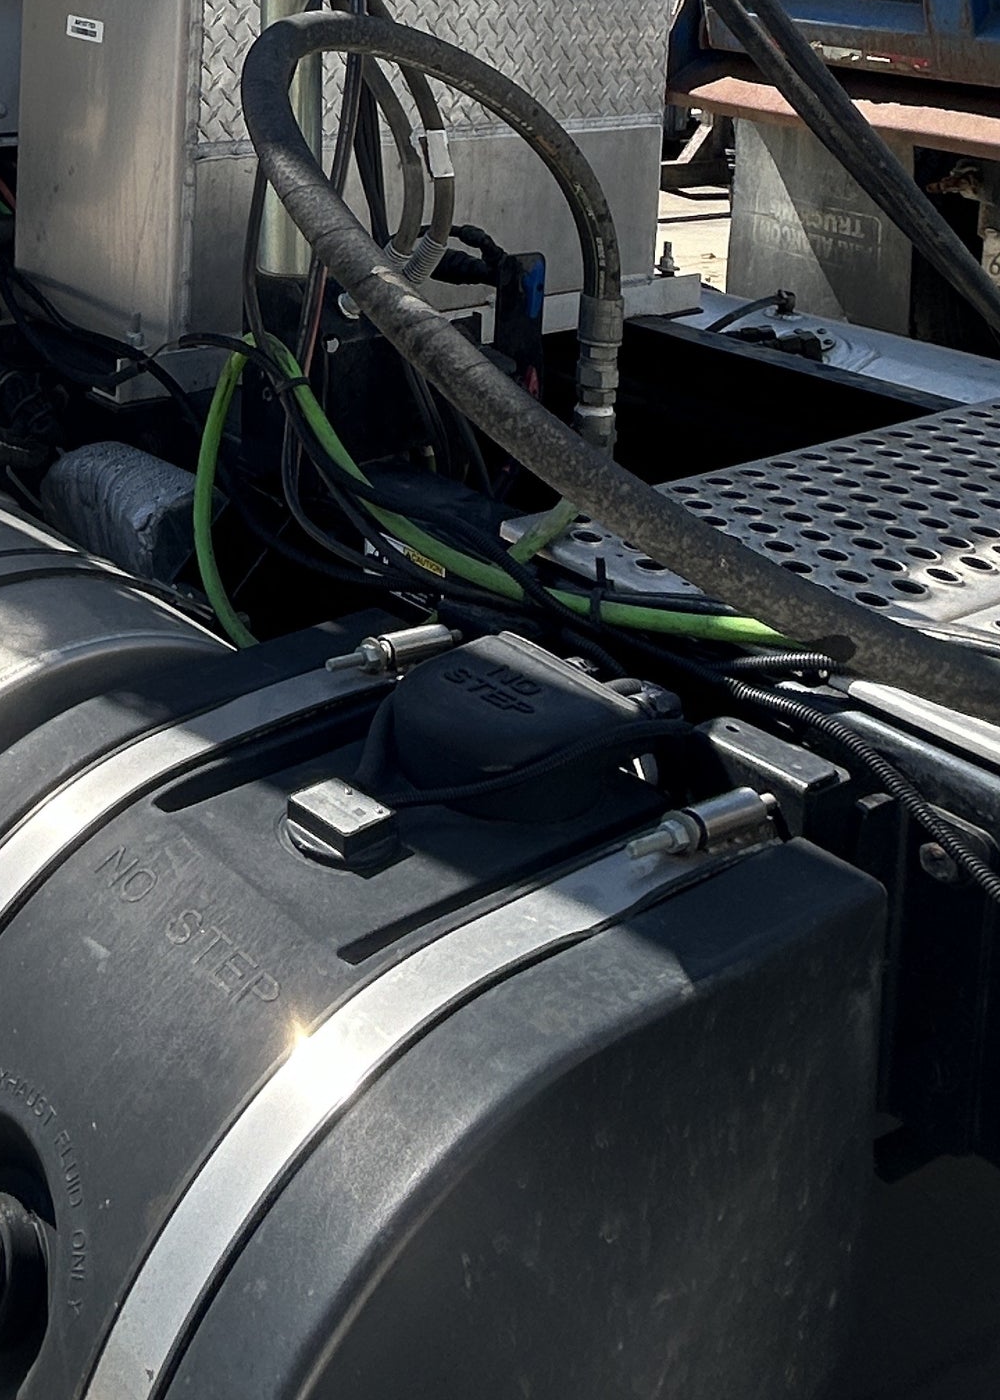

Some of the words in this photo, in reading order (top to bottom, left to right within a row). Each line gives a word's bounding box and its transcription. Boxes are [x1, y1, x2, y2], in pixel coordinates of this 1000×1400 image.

[443, 668, 536, 714] STEP
[486, 663, 542, 696] NO
[94, 845, 158, 903] NO
[165, 909, 281, 1003] STEP
[54, 1129, 83, 1208] FLUID
